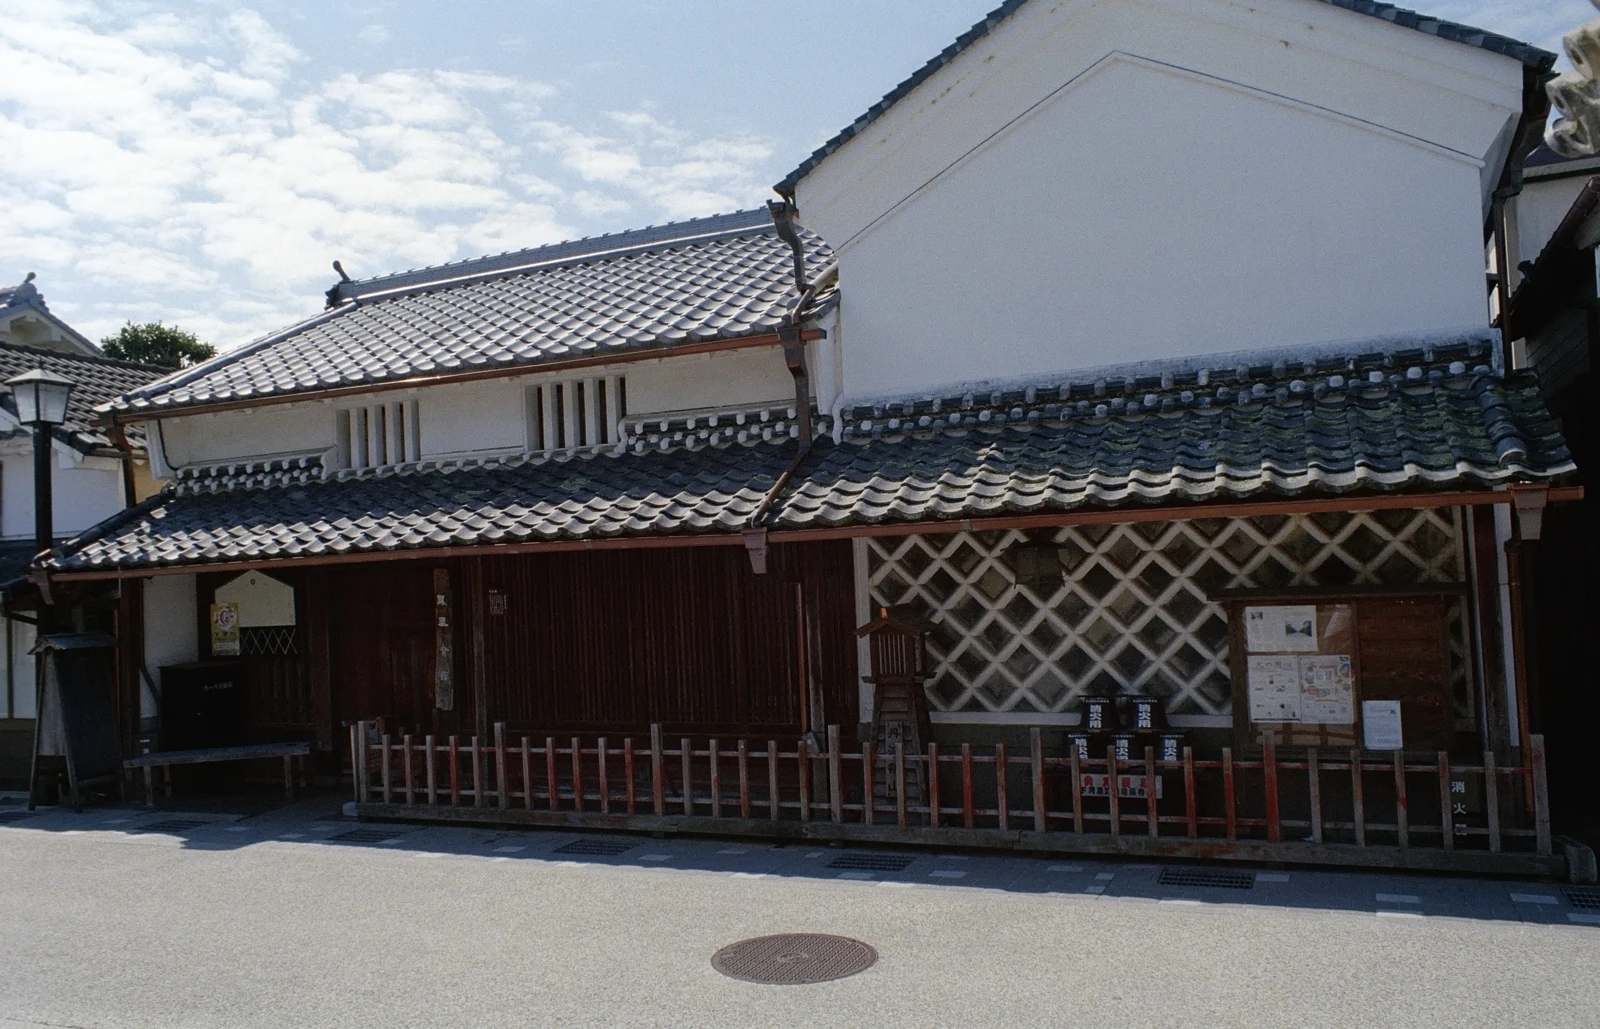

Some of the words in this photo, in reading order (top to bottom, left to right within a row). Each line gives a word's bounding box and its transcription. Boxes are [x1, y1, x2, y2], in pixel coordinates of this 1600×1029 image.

[1088, 704, 1102, 728] 消火用
[1138, 703, 1151, 728] 消火用
